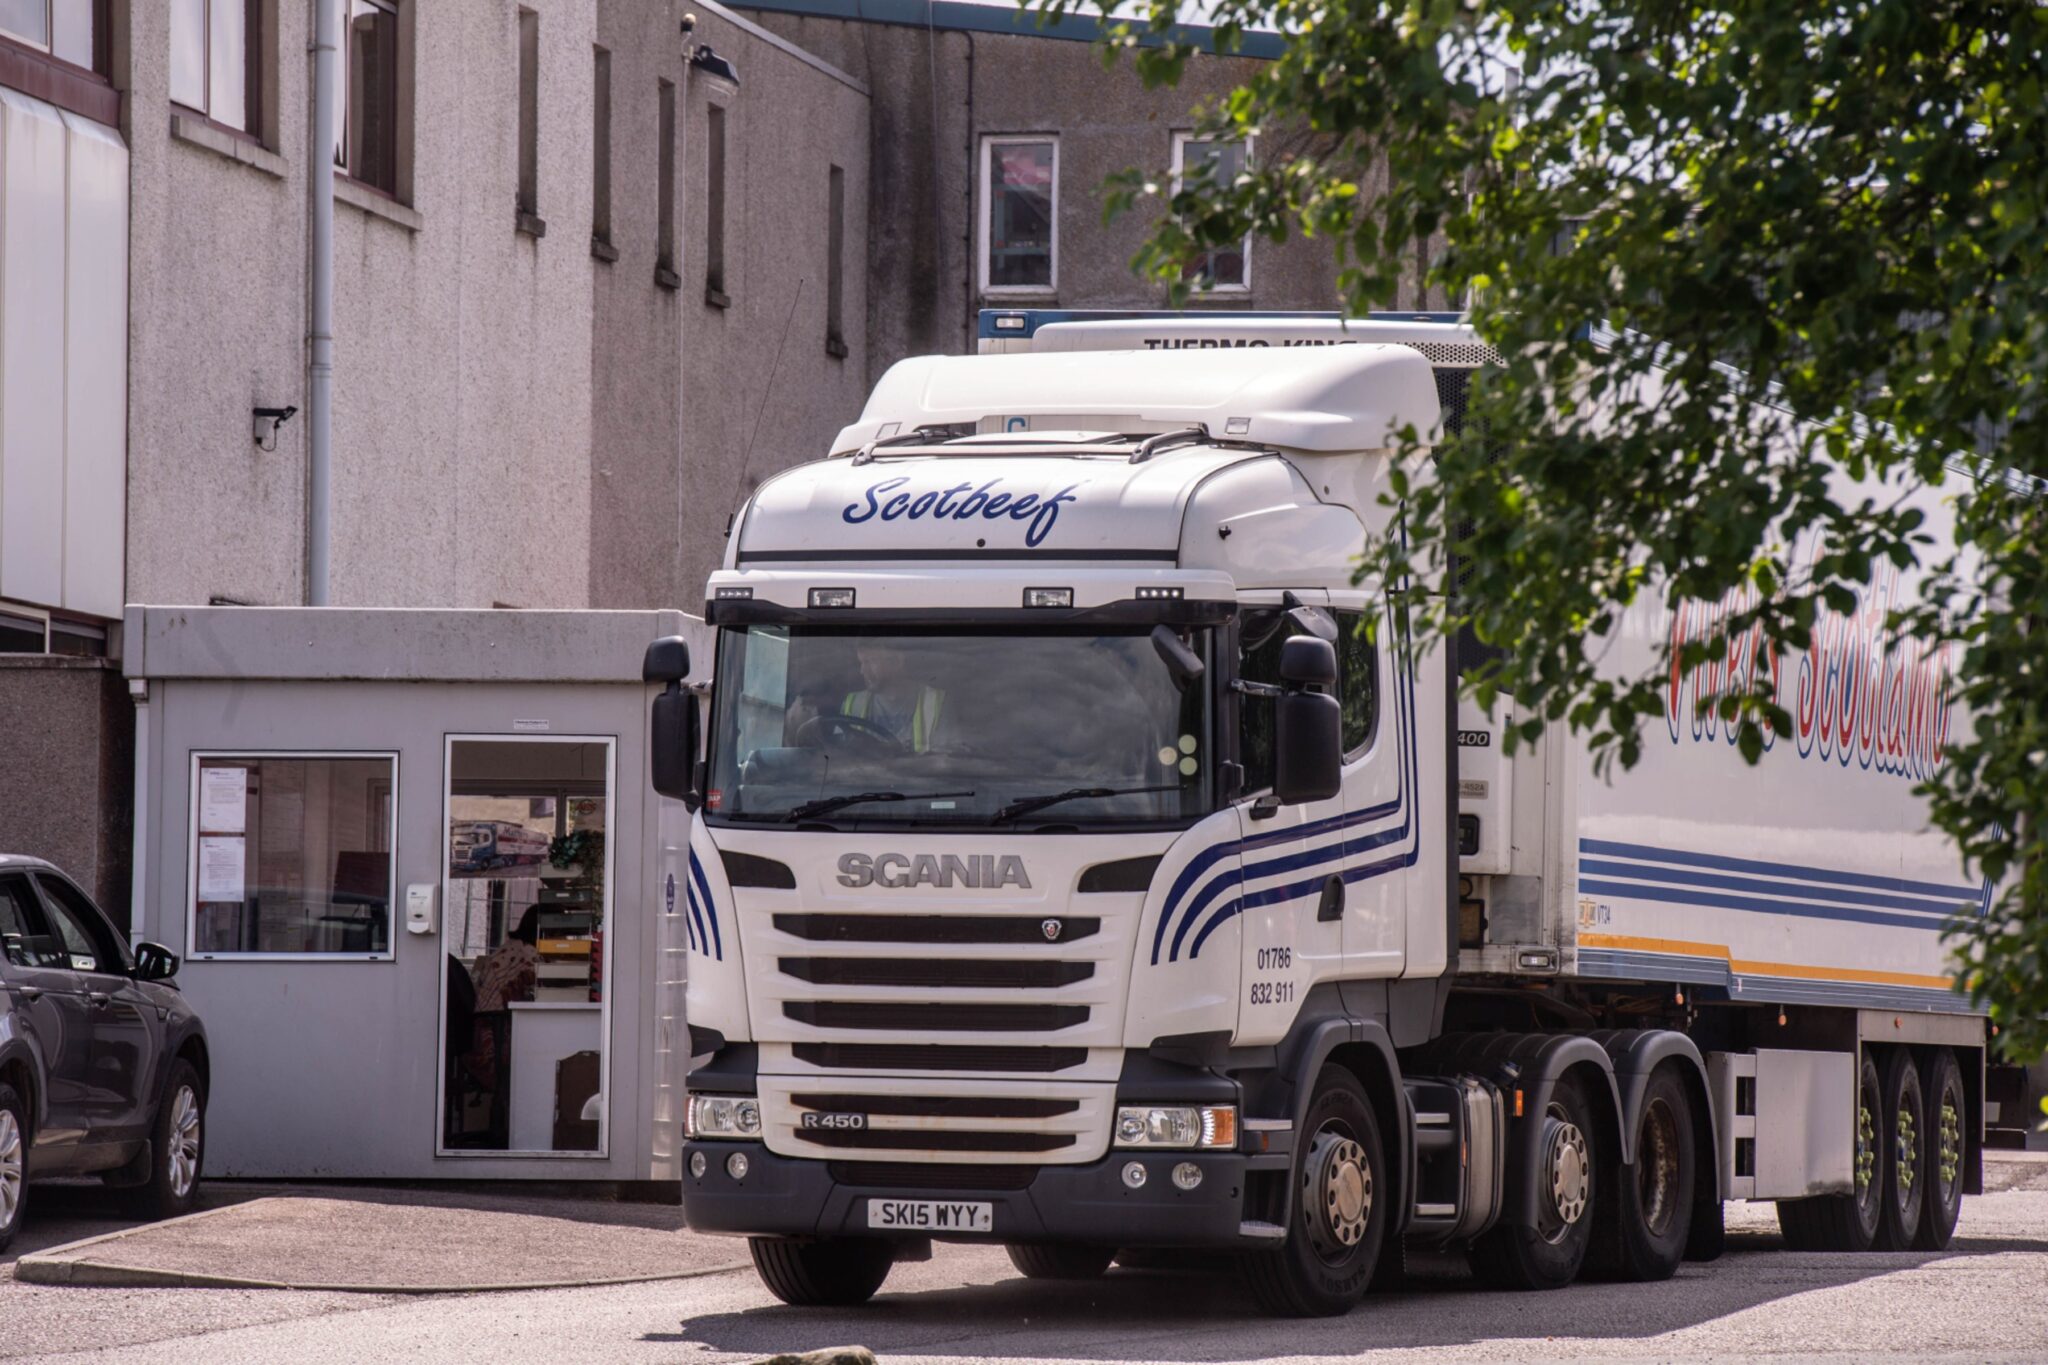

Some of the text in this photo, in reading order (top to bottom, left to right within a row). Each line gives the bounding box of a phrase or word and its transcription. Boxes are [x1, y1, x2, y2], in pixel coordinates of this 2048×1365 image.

[842, 477, 1091, 547] Scotbeef
[836, 852, 1032, 889] SCANIA
[1257, 947, 1292, 970] 01786
[1250, 980, 1294, 1005] 832 911
[804, 1114, 863, 1128] R 450
[882, 1202, 979, 1227] SK15 WYY
